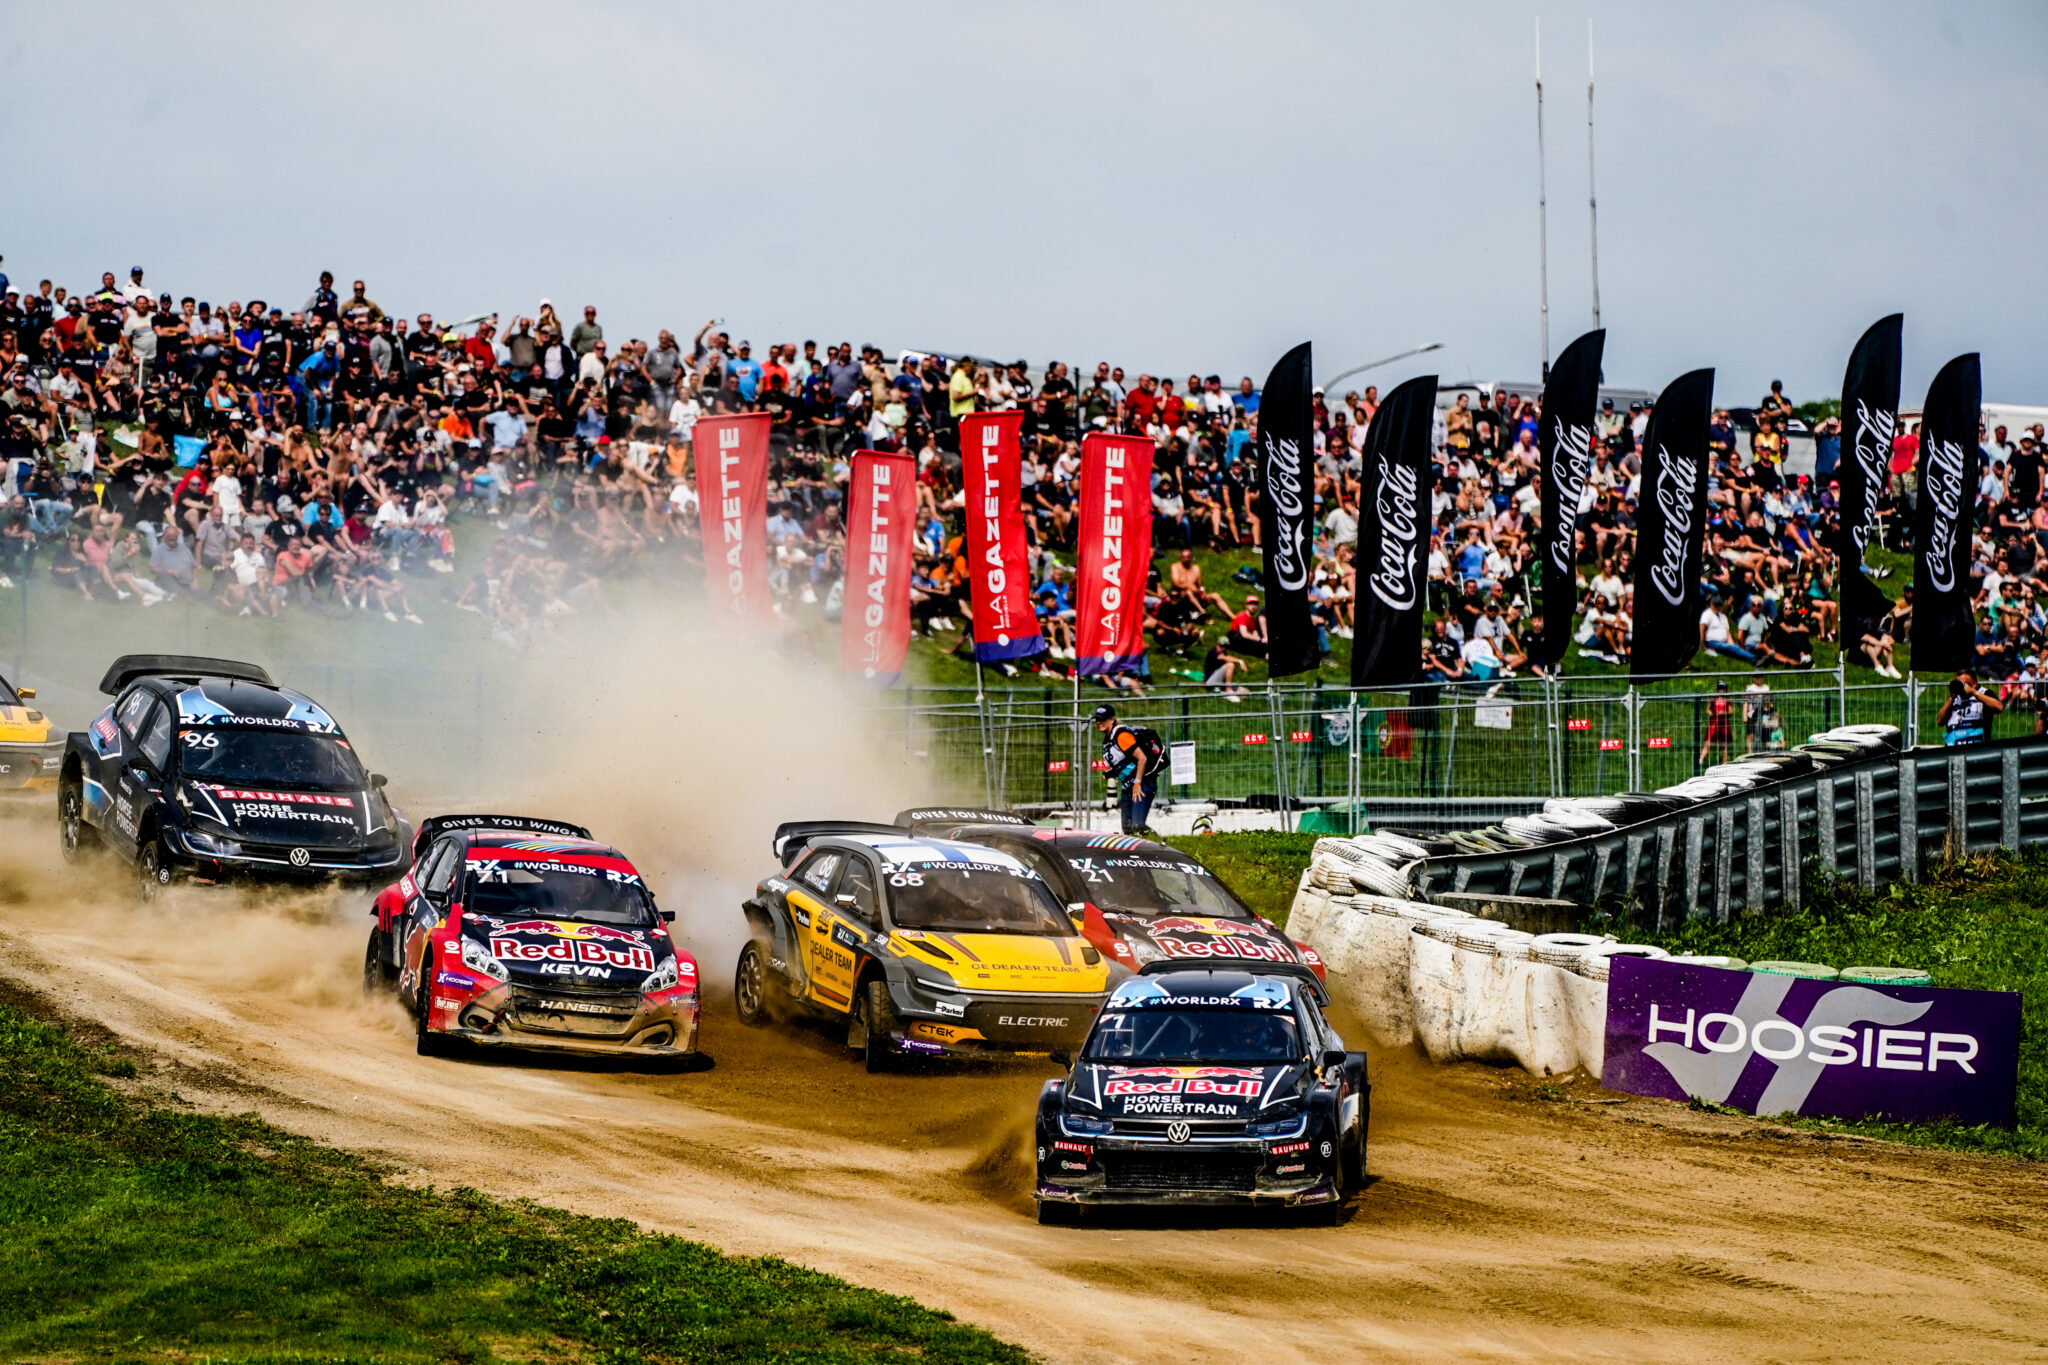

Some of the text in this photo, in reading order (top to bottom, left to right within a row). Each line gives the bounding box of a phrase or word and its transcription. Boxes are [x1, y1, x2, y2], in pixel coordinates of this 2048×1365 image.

[1265, 431, 1307, 592] Coca-Cola
[1926, 429, 1964, 593] Coca-Cola
[1369, 452, 1419, 611] Coca-Cola
[1650, 443, 1697, 606] Coca-Cola
[220, 715, 300, 729] #WORLDRX
[184, 732, 220, 748] 96
[217, 789, 354, 807] BAUHAUS
[232, 803, 293, 813] HORSE
[911, 810, 947, 820] GIVES
[948, 811, 977, 819] YOU
[235, 810, 354, 825] POWERTRAIN
[442, 818, 484, 828] GIVES
[491, 818, 523, 827] YOU
[529, 820, 578, 838] WINGS
[514, 862, 598, 876] #WORLDRX
[921, 861, 1001, 873] #WORLDRX
[1106, 859, 1176, 870] #WORLDRX
[476, 871, 508, 883] 71
[889, 872, 925, 887] 68
[1087, 869, 1114, 882] 21
[489, 937, 655, 972] Red Bull
[1155, 935, 1299, 963] Red Bull
[539, 963, 611, 979] KEVIN
[992, 964, 1040, 972] DEALER
[539, 999, 613, 1014] HANSEN
[1149, 997, 1240, 1005] #WORLDRX
[999, 1016, 1069, 1027] ELECTRIC
[918, 1024, 954, 1038] CTEK
[1648, 1003, 1978, 1074] HOOSIER
[1104, 1079, 1263, 1097] Red Bull
[1124, 1095, 1182, 1104] HORSE
[1123, 1103, 1237, 1115] POWERTRAIN
[1272, 1142, 1310, 1155] BAUHAUS
